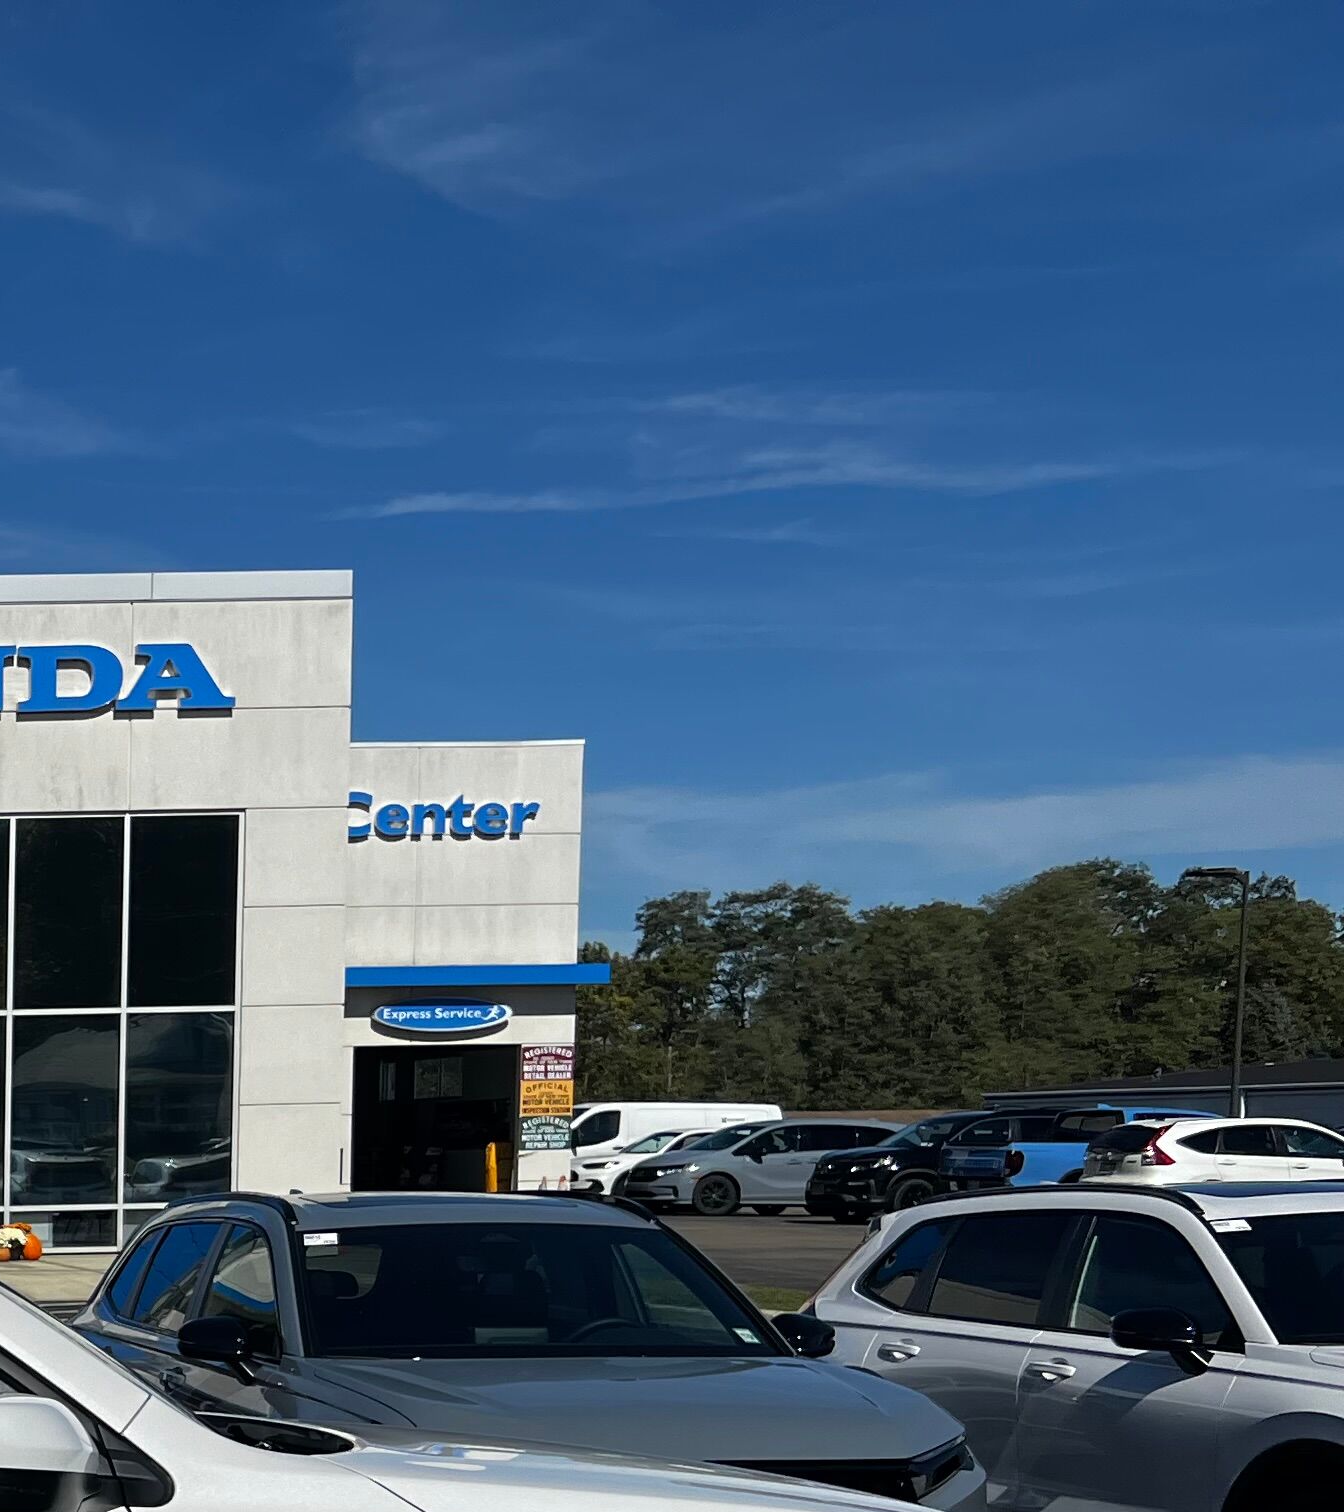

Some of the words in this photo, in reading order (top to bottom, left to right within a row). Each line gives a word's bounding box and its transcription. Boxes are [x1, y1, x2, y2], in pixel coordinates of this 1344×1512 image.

[383, 1008, 432, 1022] Express
[435, 1007, 482, 1019] Service
[523, 1046, 572, 1059] REGISTERED
[525, 1082, 568, 1093] OFFICIAL
[522, 1116, 569, 1129] REGISTERED
